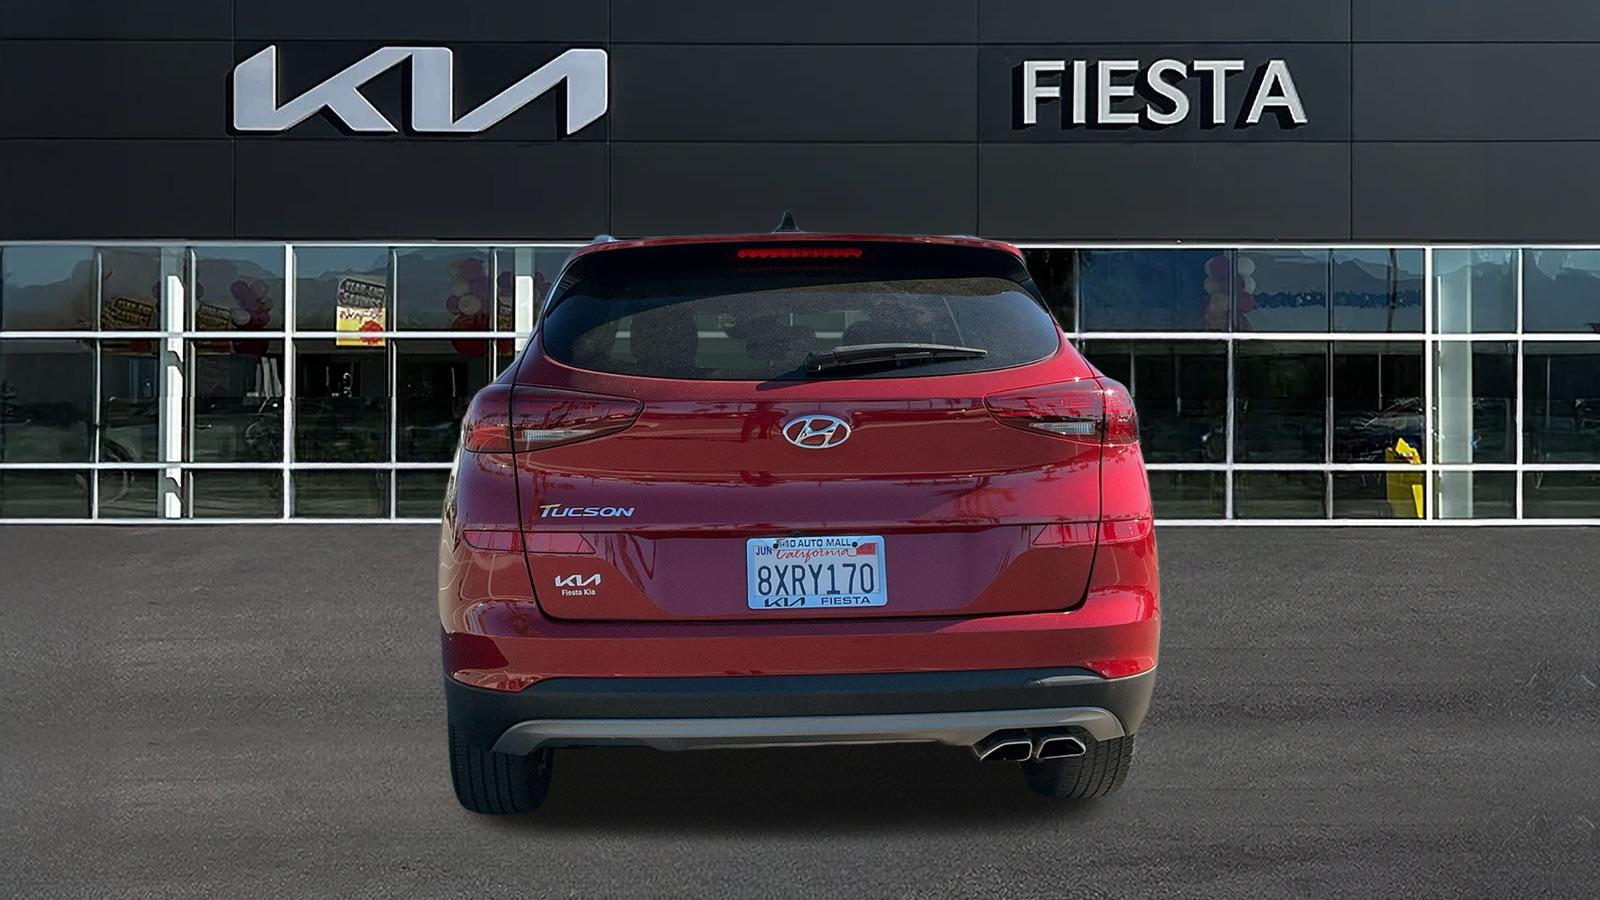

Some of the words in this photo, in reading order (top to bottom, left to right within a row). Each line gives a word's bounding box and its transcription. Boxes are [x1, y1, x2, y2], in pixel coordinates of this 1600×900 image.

[233, 44, 608, 135] KIA
[1023, 58, 1308, 125] FIESTA
[540, 503, 635, 518] TUCSON
[755, 545, 773, 556] JUN
[798, 539, 823, 548] AUTO
[826, 538, 851, 547] MALL
[776, 547, 857, 563] California
[757, 563, 875, 596] 8XRY170
[821, 596, 871, 606] FIESTA
